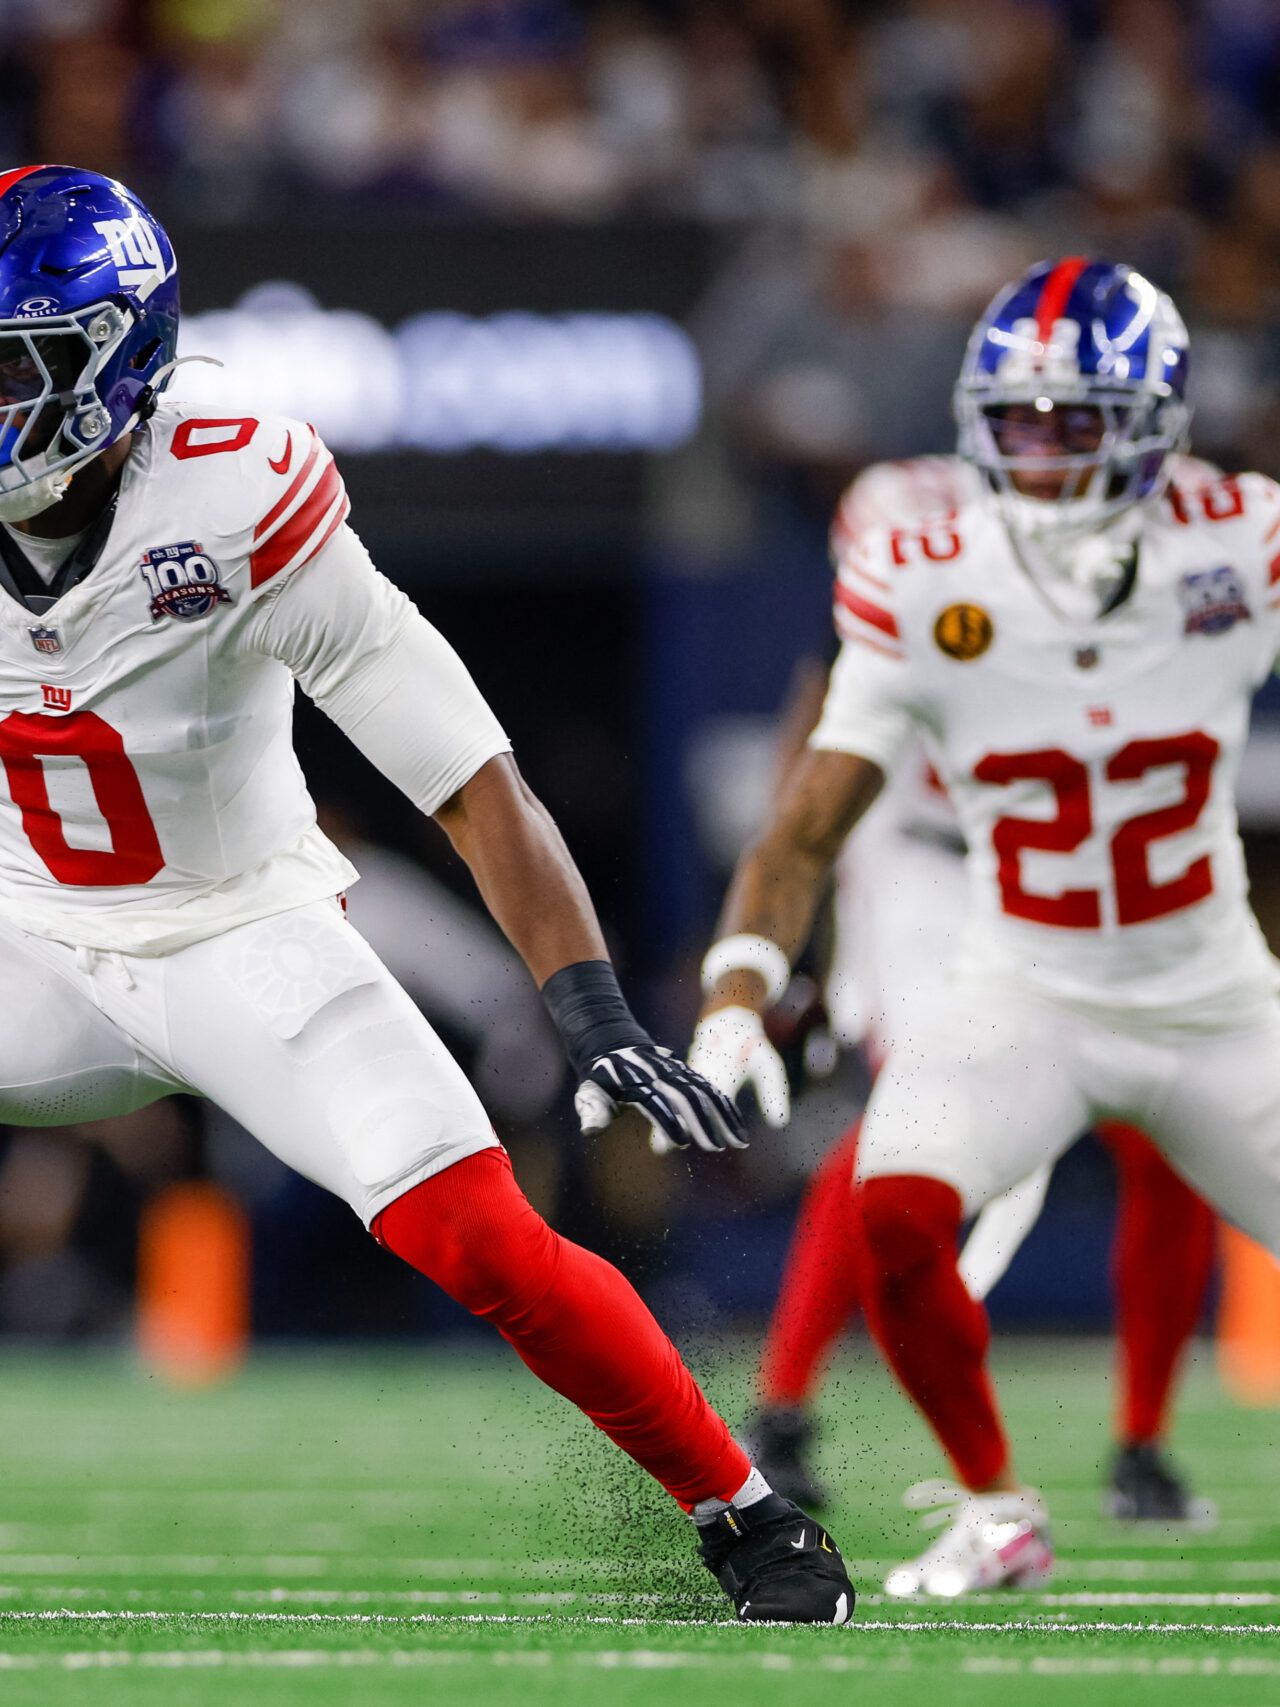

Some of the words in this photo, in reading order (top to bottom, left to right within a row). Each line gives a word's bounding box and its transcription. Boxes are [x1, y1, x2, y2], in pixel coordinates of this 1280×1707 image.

[16, 307, 58, 320] OAKLEY
[170, 417, 260, 460] 0
[141, 556, 217, 595] 100
[157, 586, 215, 604] SEASONS
[35, 639, 60, 652] NFL
[973, 730, 1222, 931] 22
